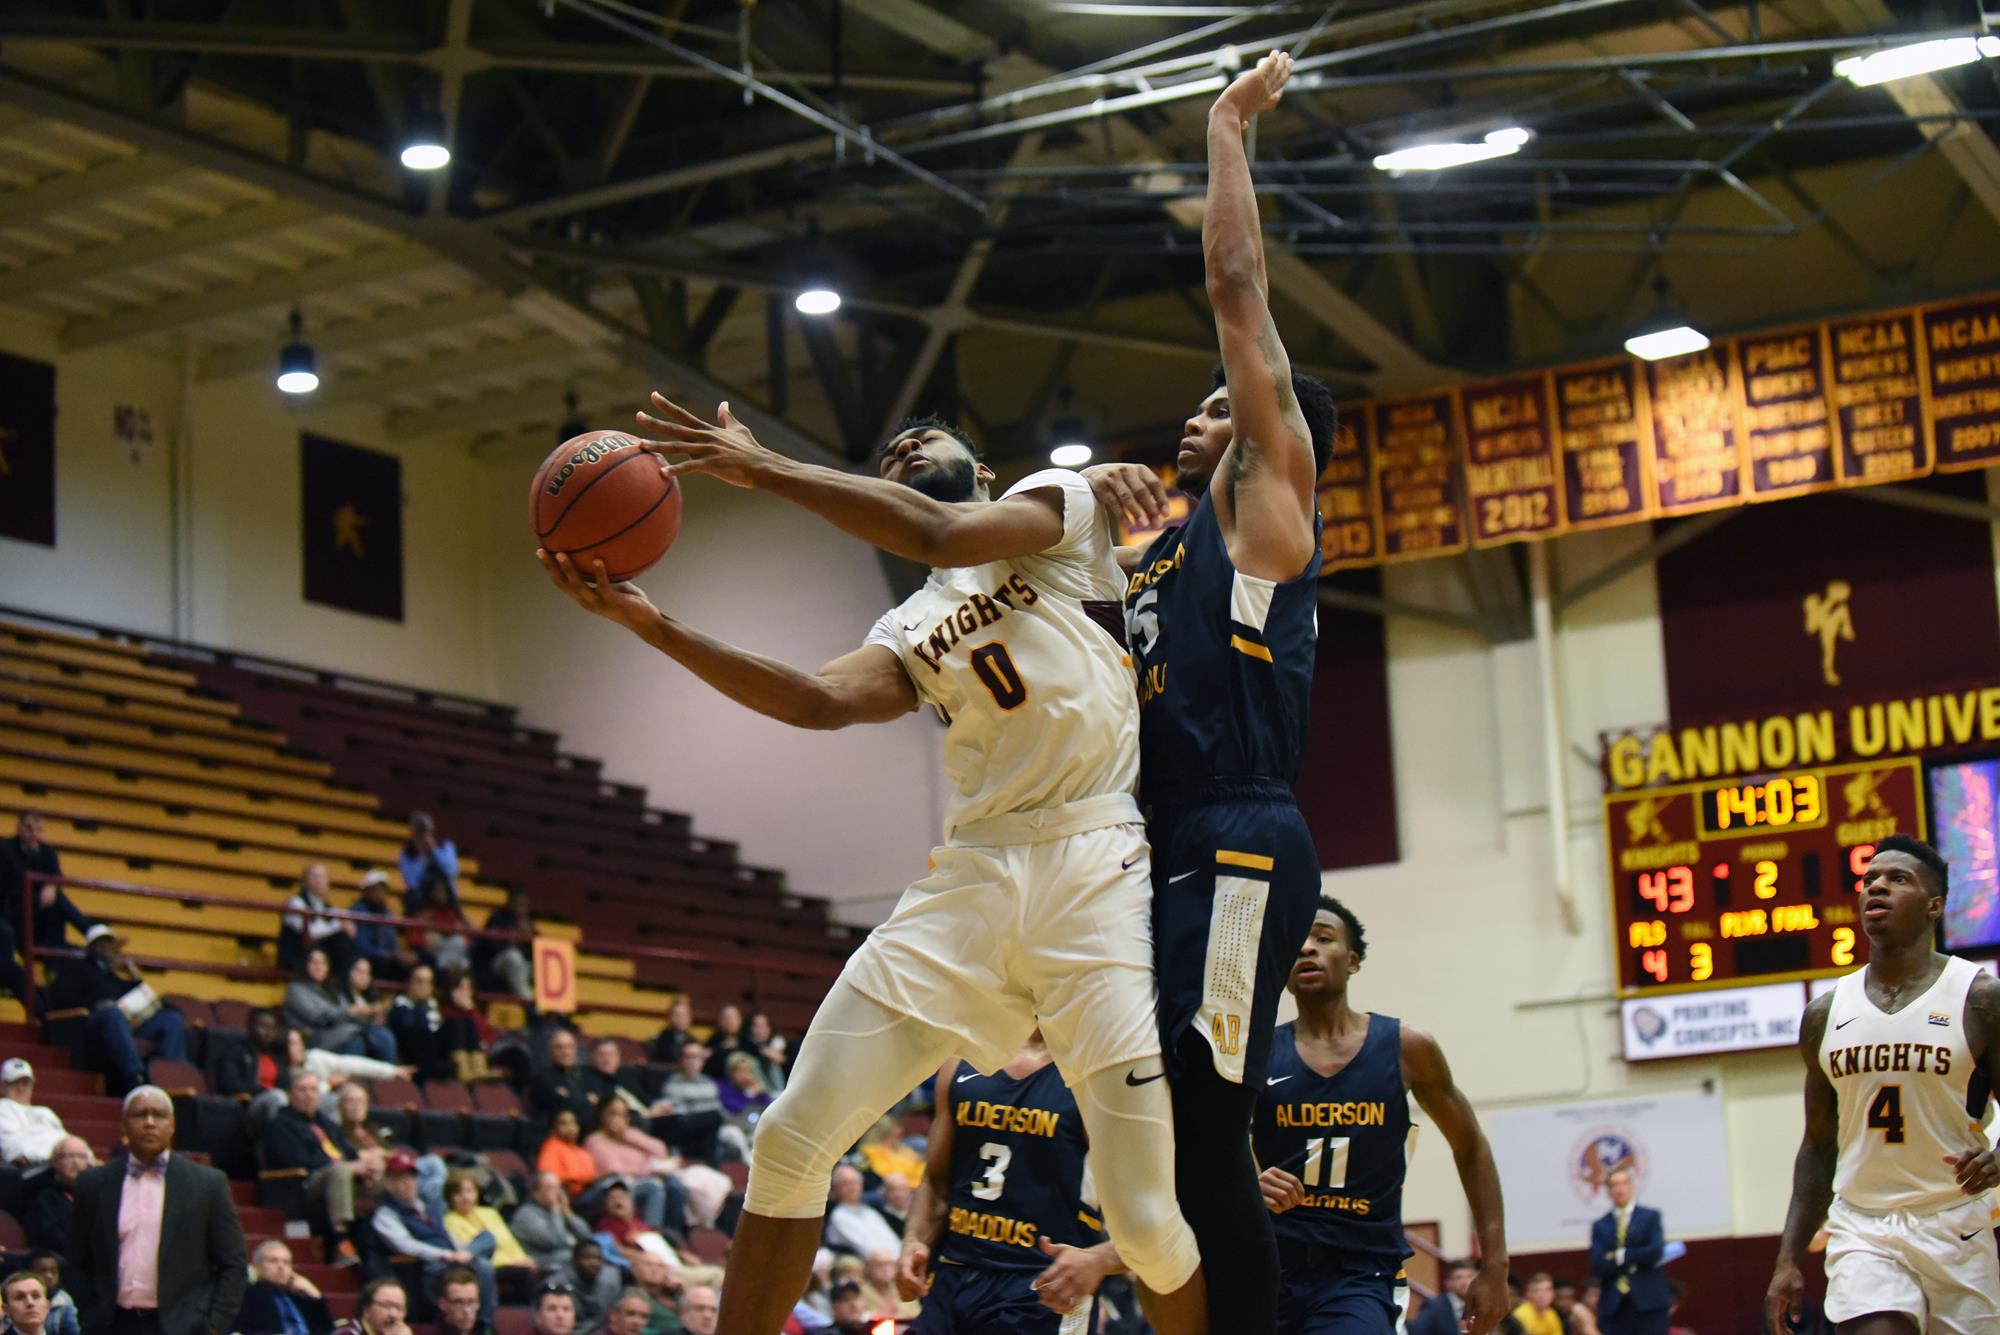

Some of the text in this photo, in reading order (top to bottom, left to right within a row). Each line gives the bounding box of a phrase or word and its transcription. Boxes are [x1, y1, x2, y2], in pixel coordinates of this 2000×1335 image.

[1838, 322, 1906, 355] NCAA
[1931, 314, 2000, 349] NCAA
[546, 434, 638, 497] Wilson
[1482, 489, 1550, 535] 2012
[913, 572, 1039, 675] KNIGHTS
[967, 640, 1028, 712] 0
[1609, 687, 2000, 788] GANNON UNIVE
[1716, 774, 1821, 830] 14:03
[1638, 865, 1695, 914] 43
[1754, 859, 1779, 900] 2
[1642, 948, 1669, 982] 4
[1689, 942, 1714, 981] 3
[1831, 926, 1857, 967] 2
[542, 949, 569, 999] D
[1673, 999, 1749, 1021] PRINTING
[1212, 1012, 1241, 1056] AB
[1829, 1042, 1952, 1079] KNIGHTS
[1276, 1102, 1386, 1128] ALDERSON
[1867, 1082, 1906, 1146] 4
[971, 1142, 1012, 1201] 3
[1303, 1136, 1350, 1189] 11
